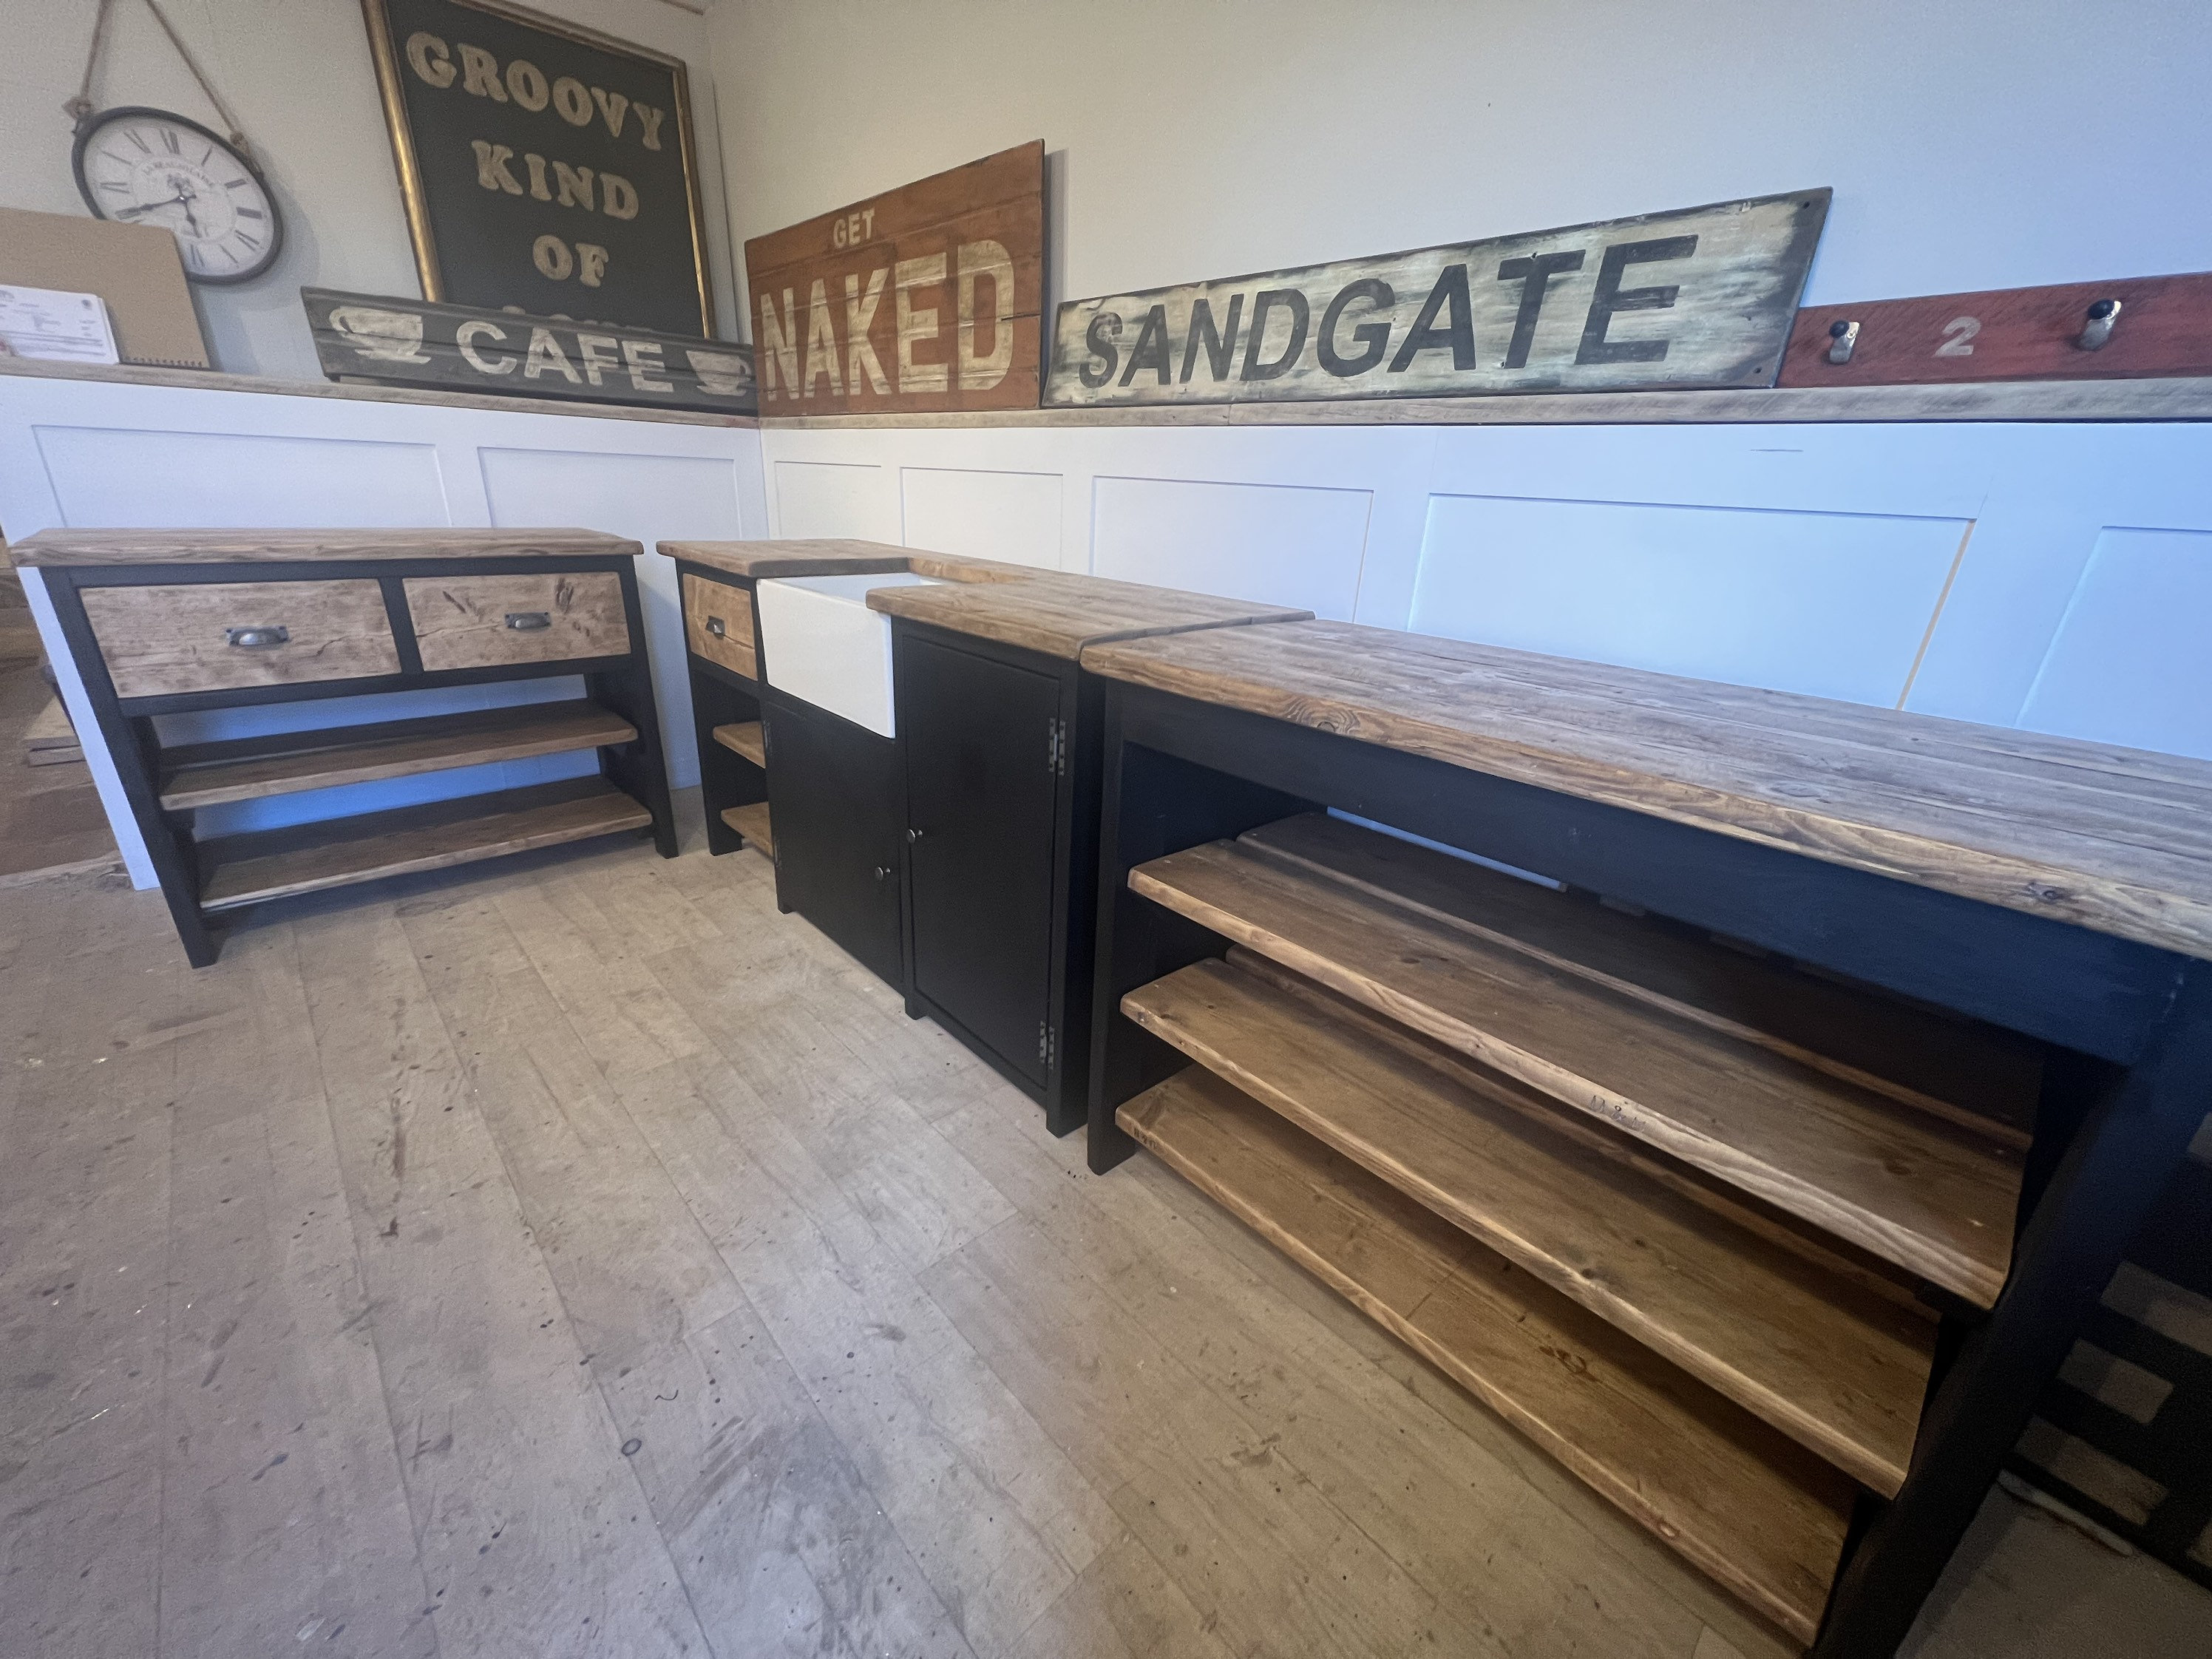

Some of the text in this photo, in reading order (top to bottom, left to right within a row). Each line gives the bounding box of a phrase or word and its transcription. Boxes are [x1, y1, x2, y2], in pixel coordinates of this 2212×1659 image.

[406, 31, 664, 151] GROOVY
[471, 139, 639, 220] KIND
[532, 234, 609, 288] OF
[833, 208, 875, 248] GET
[760, 240, 1015, 401] NAKED
[1077, 234, 1699, 389] SANDGATE
[1934, 316, 1982, 358] 2
[456, 320, 674, 393] CAFE
